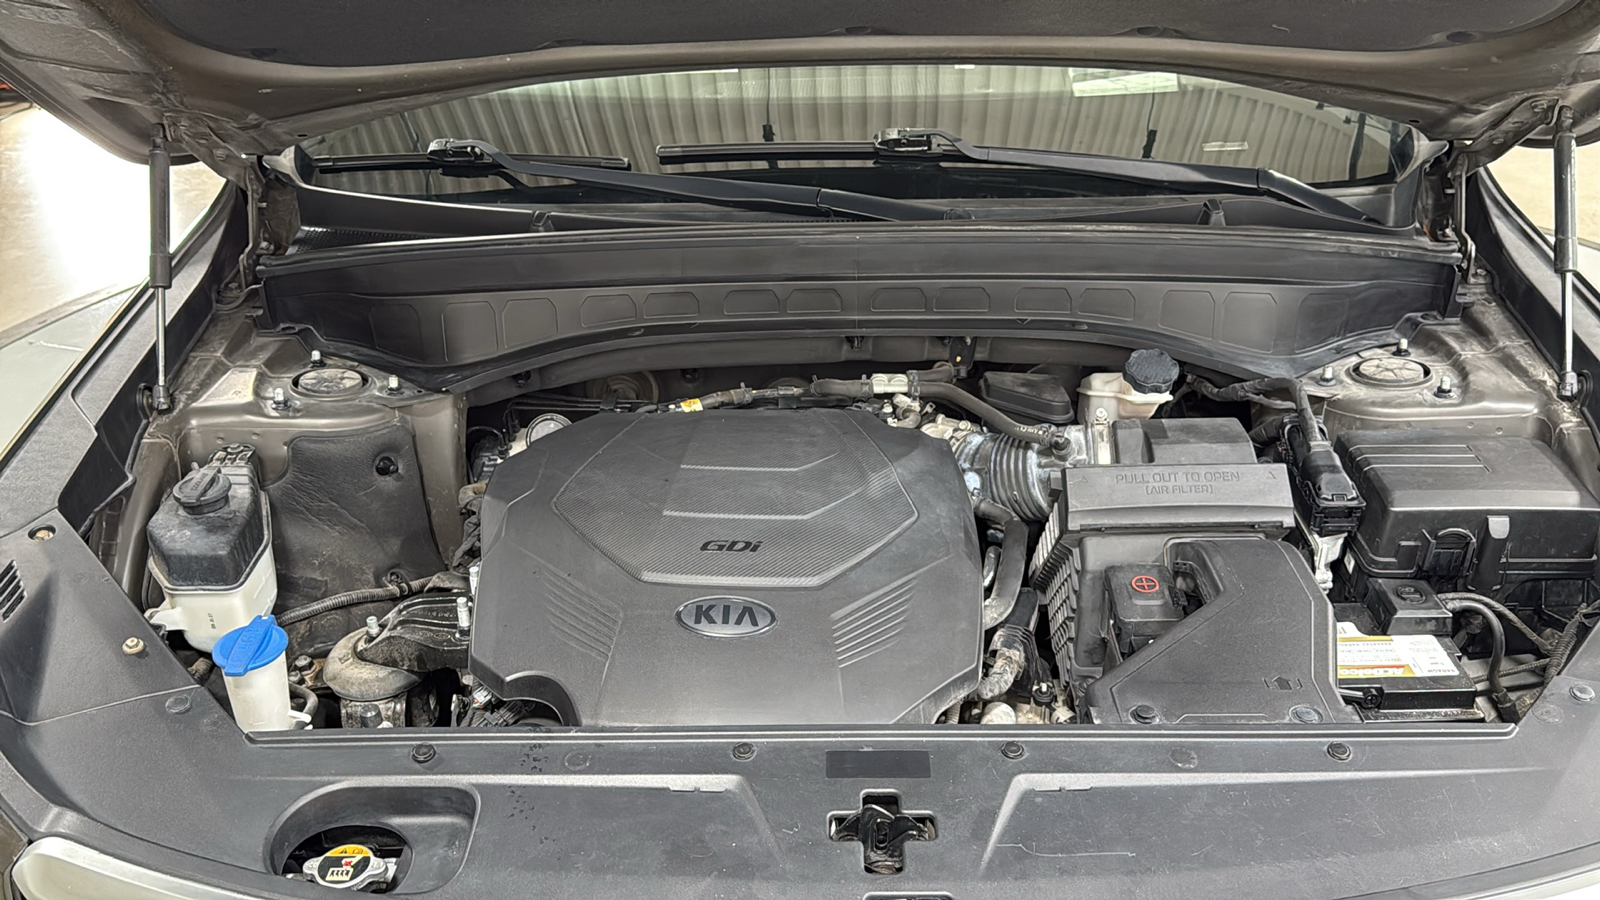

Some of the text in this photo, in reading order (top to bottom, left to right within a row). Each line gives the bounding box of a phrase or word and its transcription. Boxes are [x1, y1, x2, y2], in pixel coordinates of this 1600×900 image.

[1116, 471, 1240, 484] PULL OUT TO OPEN
[1146, 484, 1214, 495] (AIR FILTER)
[700, 540, 763, 552] GDi
[694, 604, 759, 627] KIA
